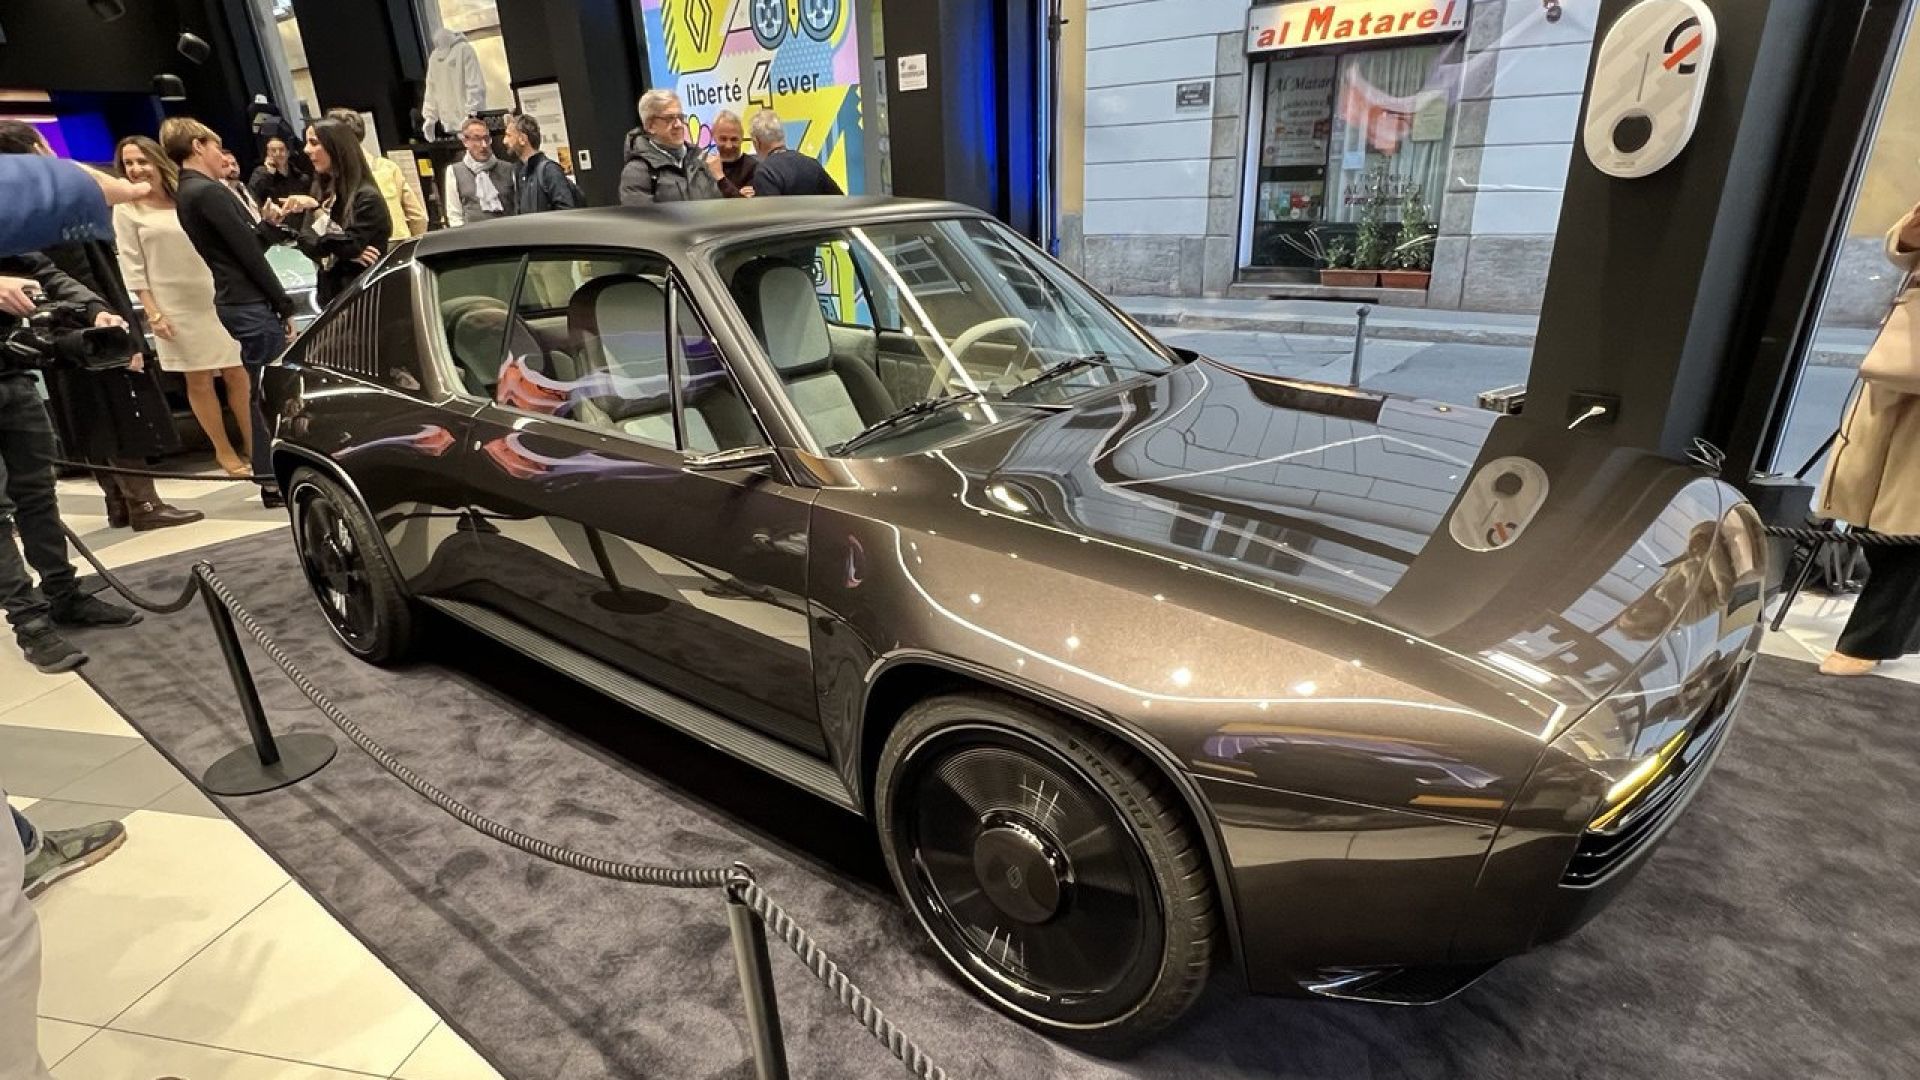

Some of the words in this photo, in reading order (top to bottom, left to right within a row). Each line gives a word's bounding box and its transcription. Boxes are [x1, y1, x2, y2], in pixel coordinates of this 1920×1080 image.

[686, 78, 742, 107] liberté
[747, 60, 774, 110] 4
[777, 73, 820, 96] ever
